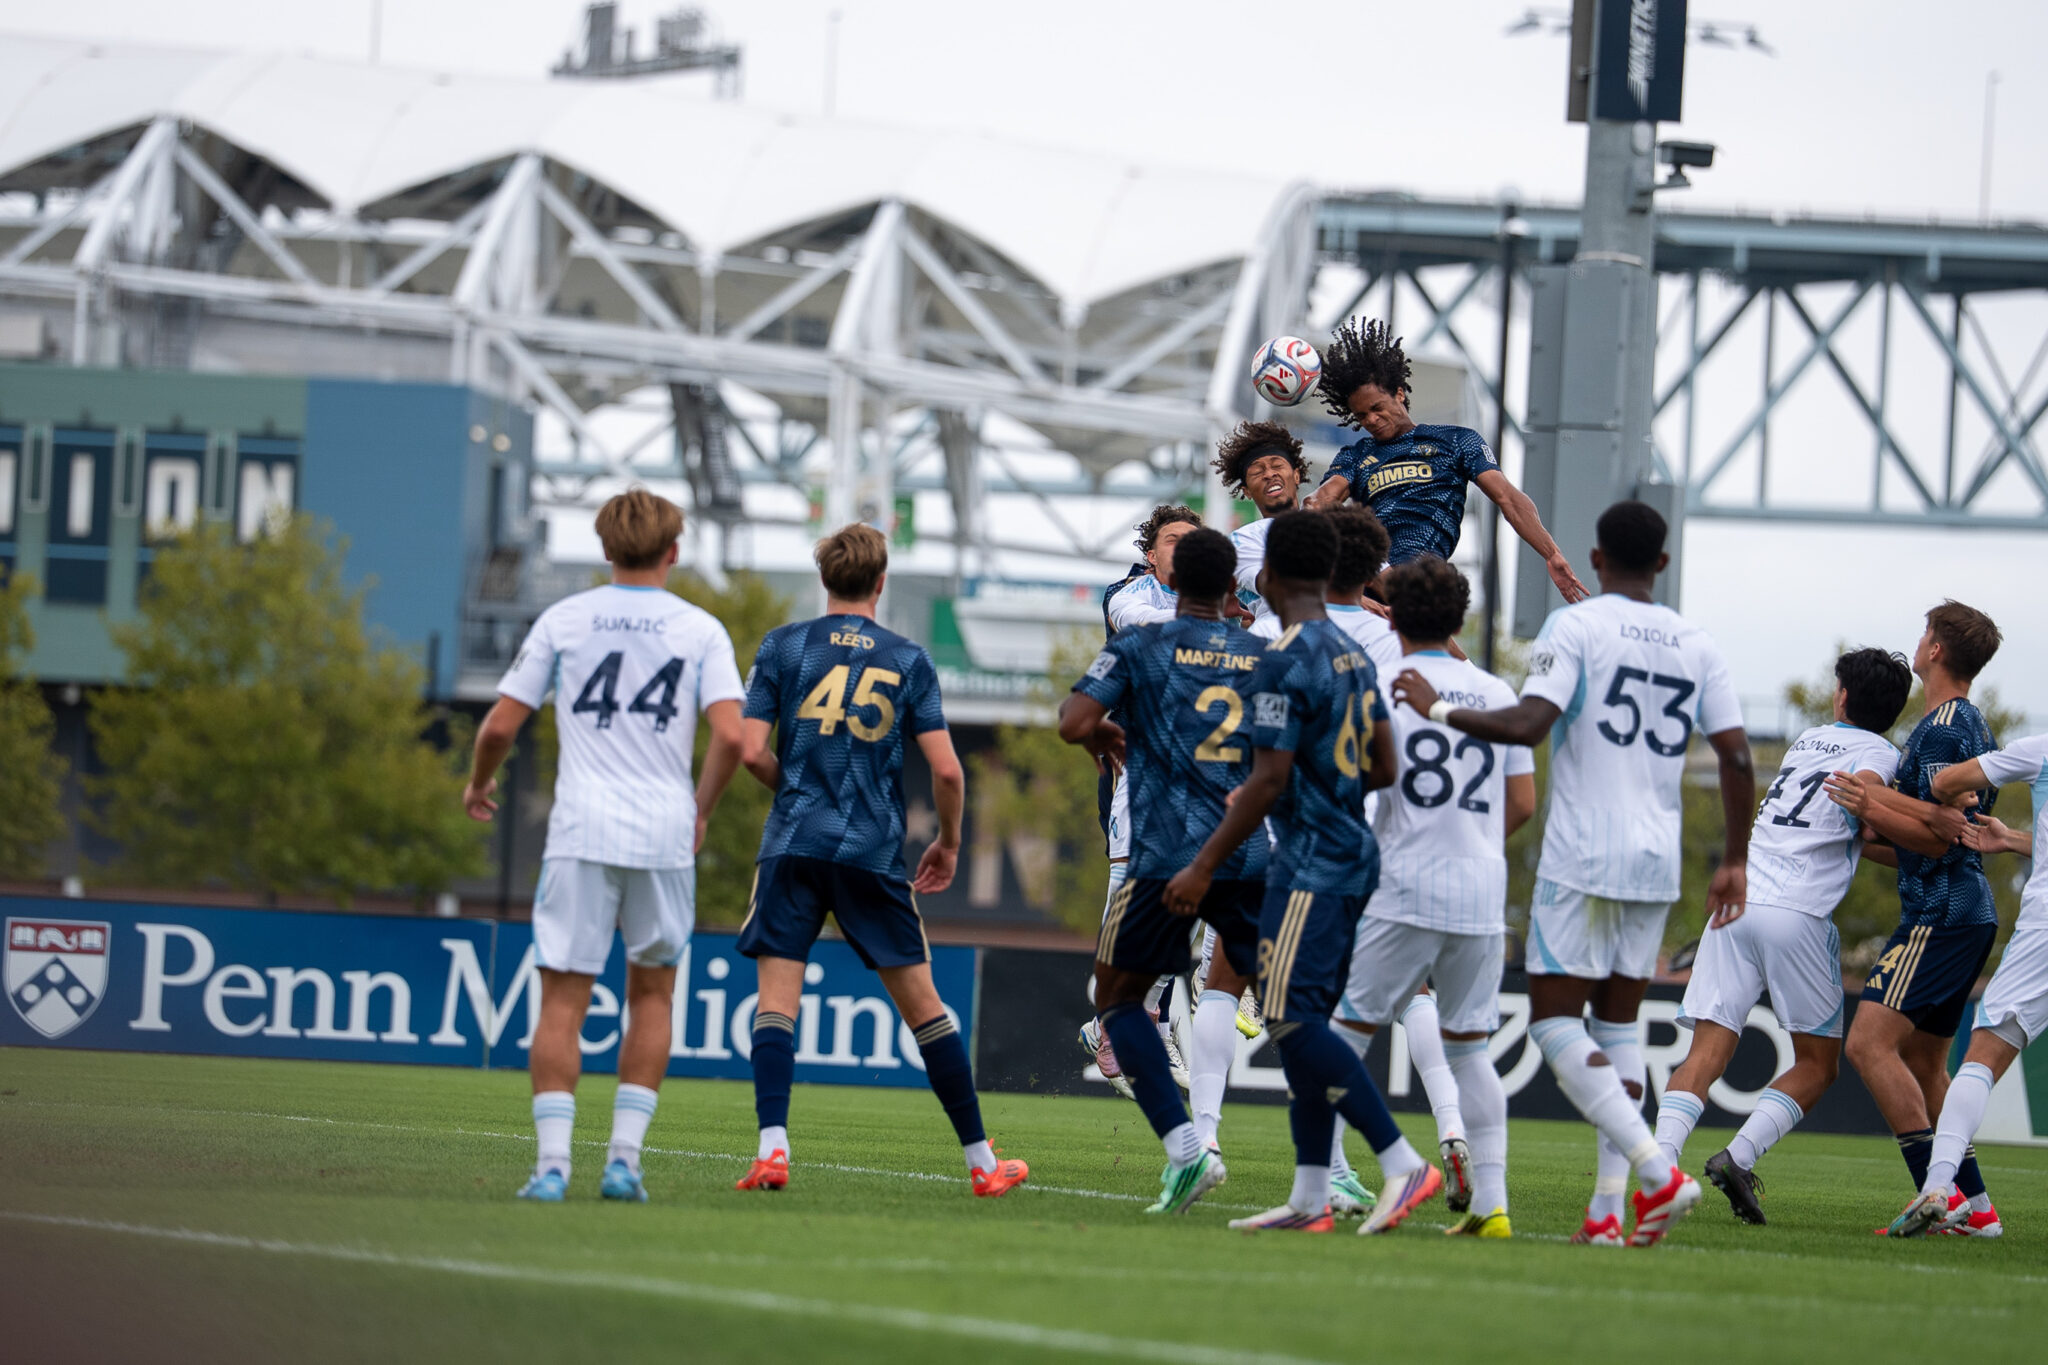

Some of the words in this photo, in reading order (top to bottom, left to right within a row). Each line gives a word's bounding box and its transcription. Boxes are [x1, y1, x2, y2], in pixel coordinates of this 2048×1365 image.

[0, 450, 295, 544] ION
[1368, 464, 1433, 493] BIMBO
[830, 632, 876, 650] REED
[1175, 648, 1261, 671] MARTINE
[1620, 623, 1681, 650] LOIOLA
[572, 651, 685, 733] 44
[796, 664, 902, 743] 45
[1193, 685, 1244, 763] 2
[1438, 690, 1487, 709] MPOS
[1597, 665, 1696, 757] 53
[1401, 728, 1495, 814] 82
[129, 922, 420, 1044] Penn
[1877, 943, 1906, 974] 4
